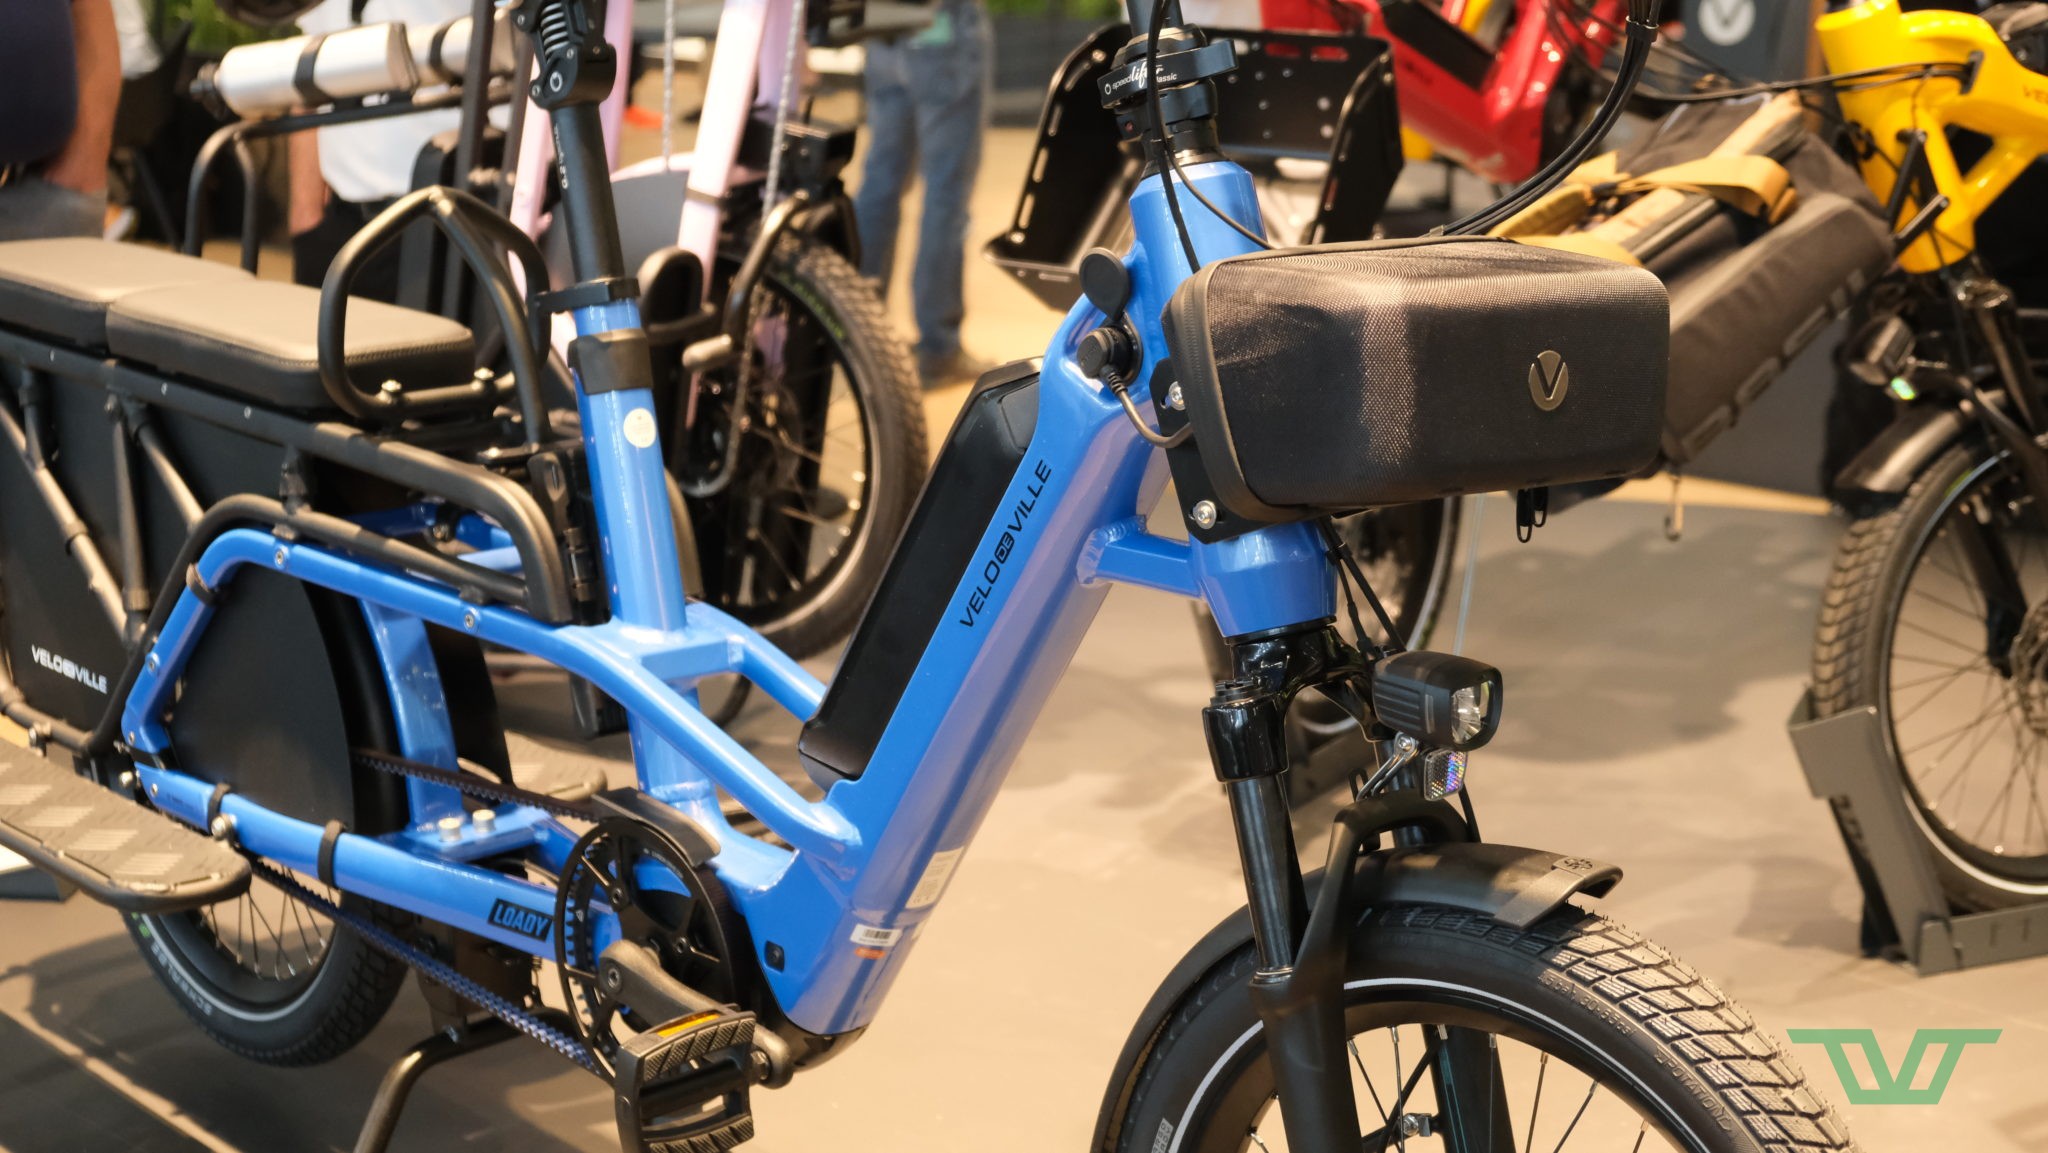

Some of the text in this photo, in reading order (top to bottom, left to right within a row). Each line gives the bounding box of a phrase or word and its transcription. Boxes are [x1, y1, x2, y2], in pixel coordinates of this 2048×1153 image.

[1156, 72, 1177, 84] lassic
[31, 643, 107, 695] VELOVILLE
[493, 903, 549, 937] LOADY
